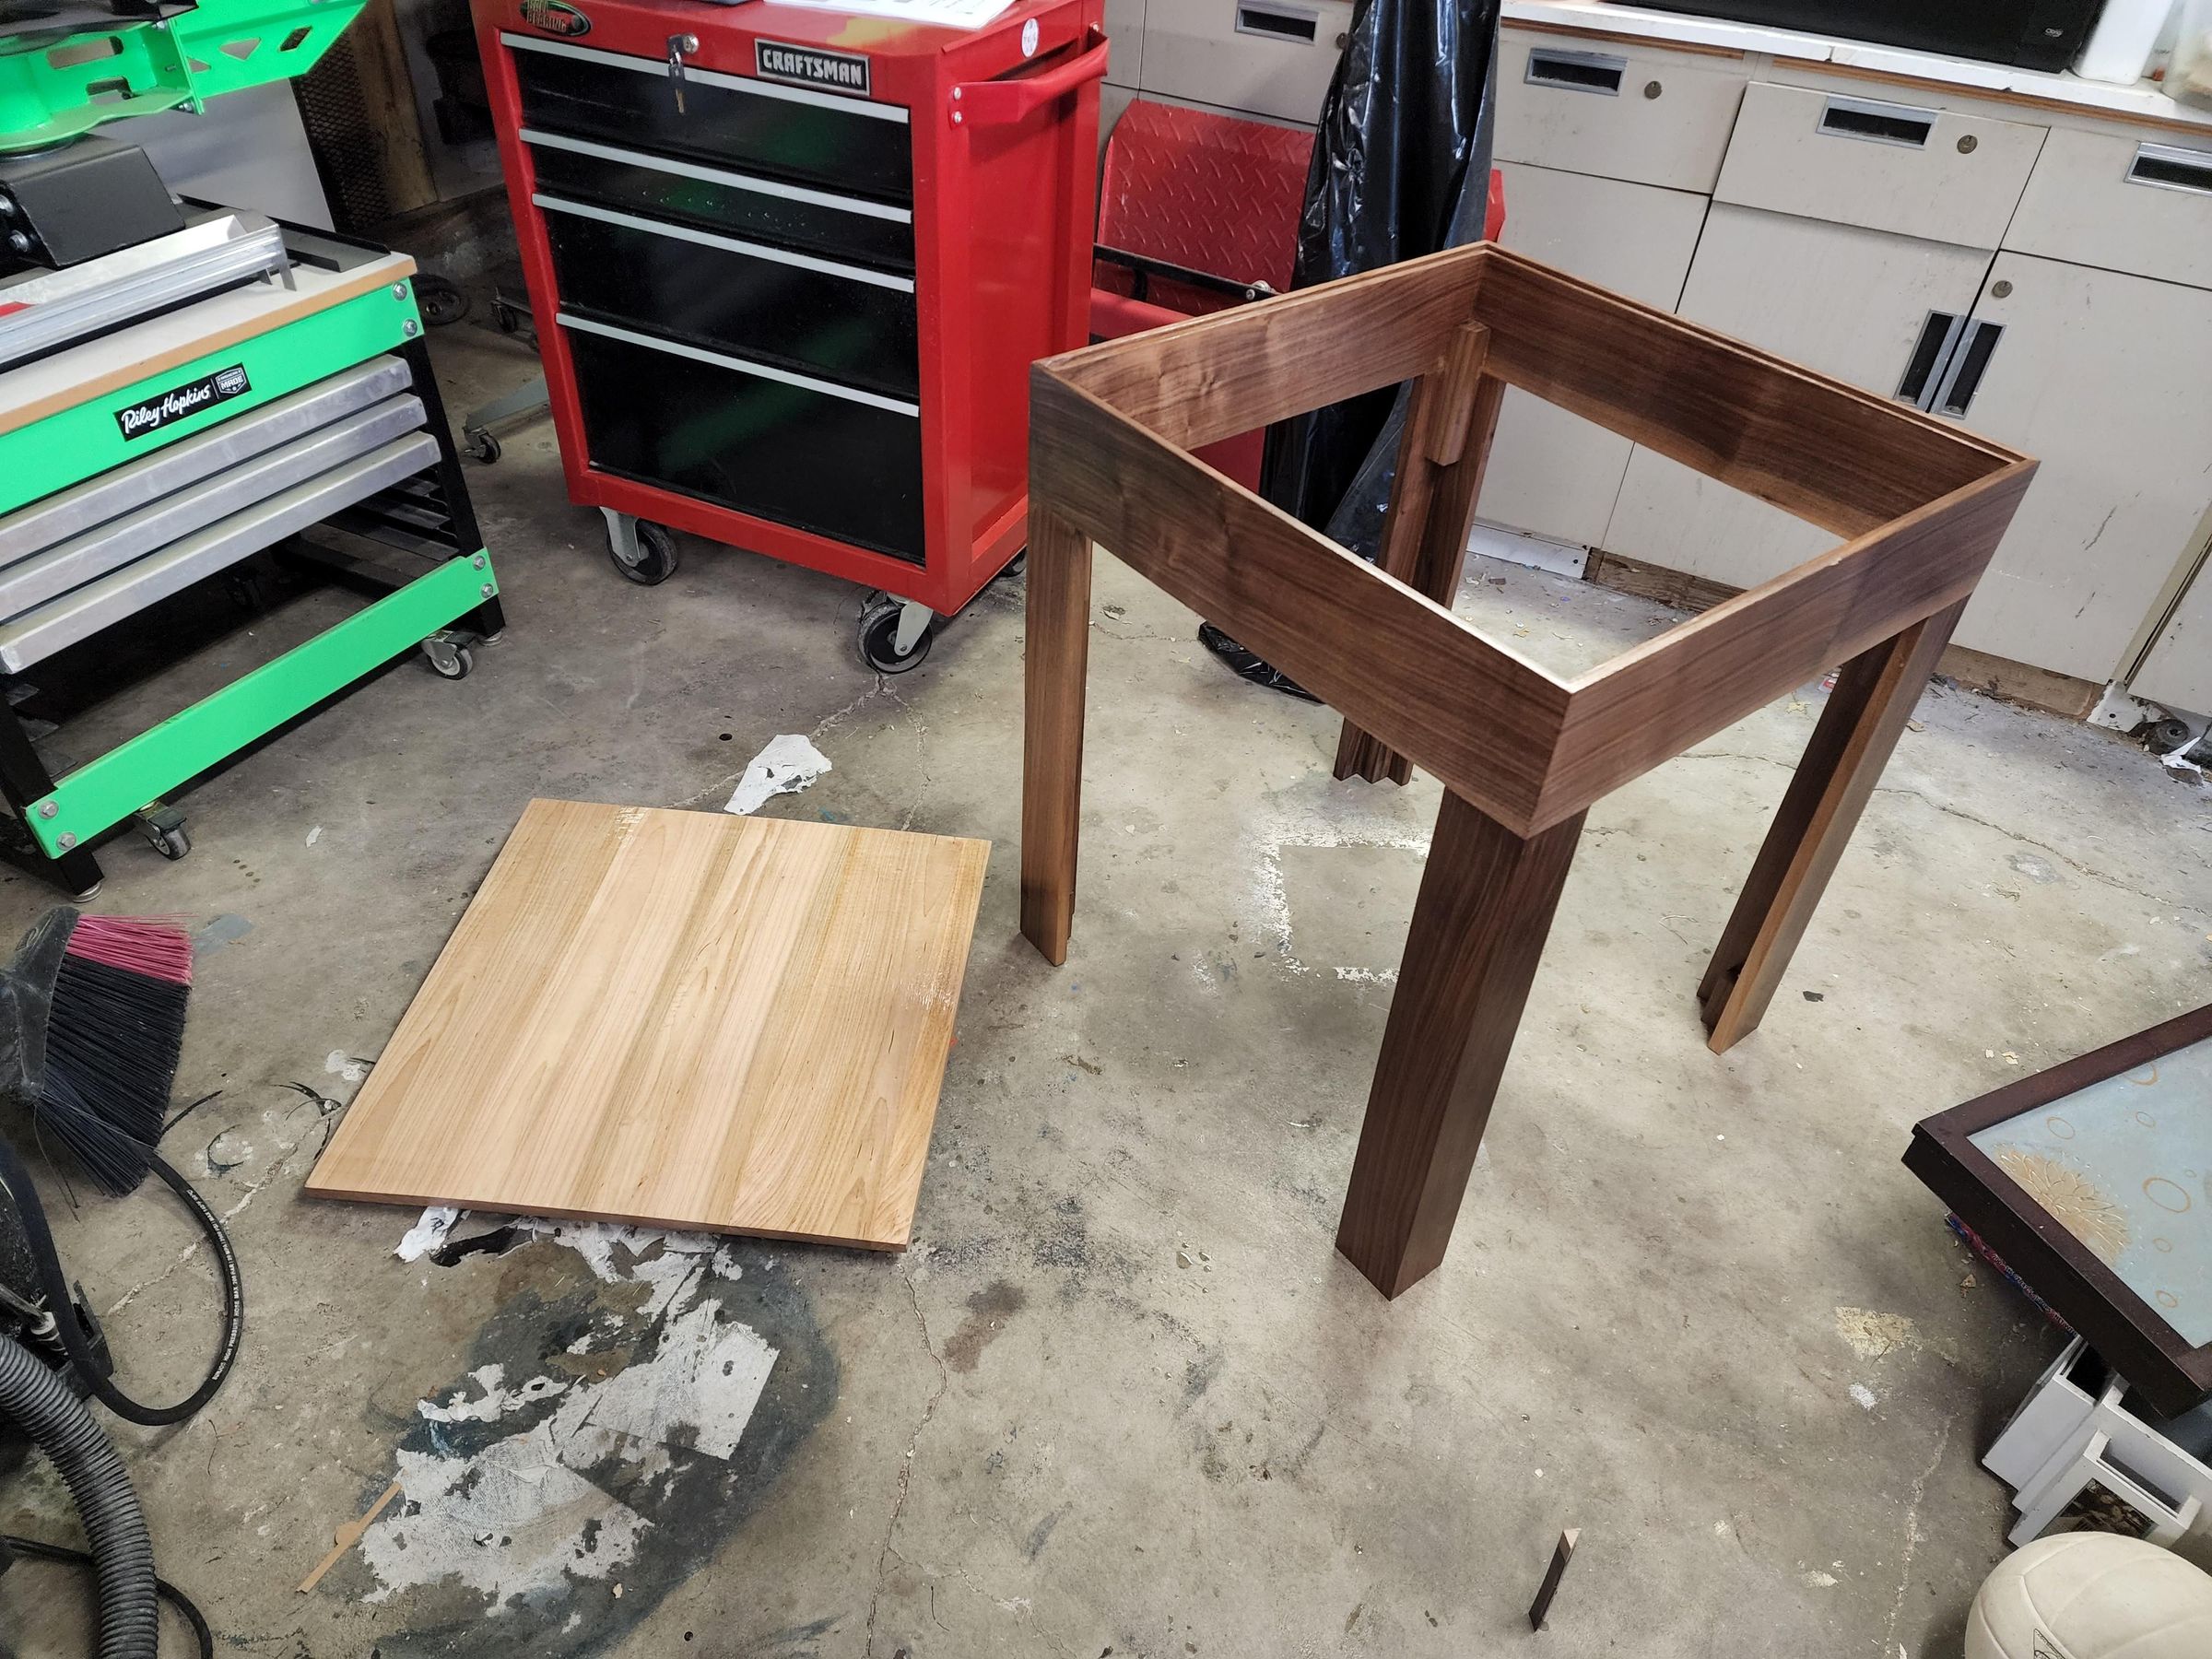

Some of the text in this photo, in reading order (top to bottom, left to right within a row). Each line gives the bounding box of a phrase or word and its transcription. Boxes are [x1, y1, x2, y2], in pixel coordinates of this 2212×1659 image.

[762, 49, 863, 86] CRAFTSMAN
[220, 375, 244, 390] MADE
[121, 384, 211, 434] Riley Hopkins
[228, 1317, 240, 1347] PRESSURE
